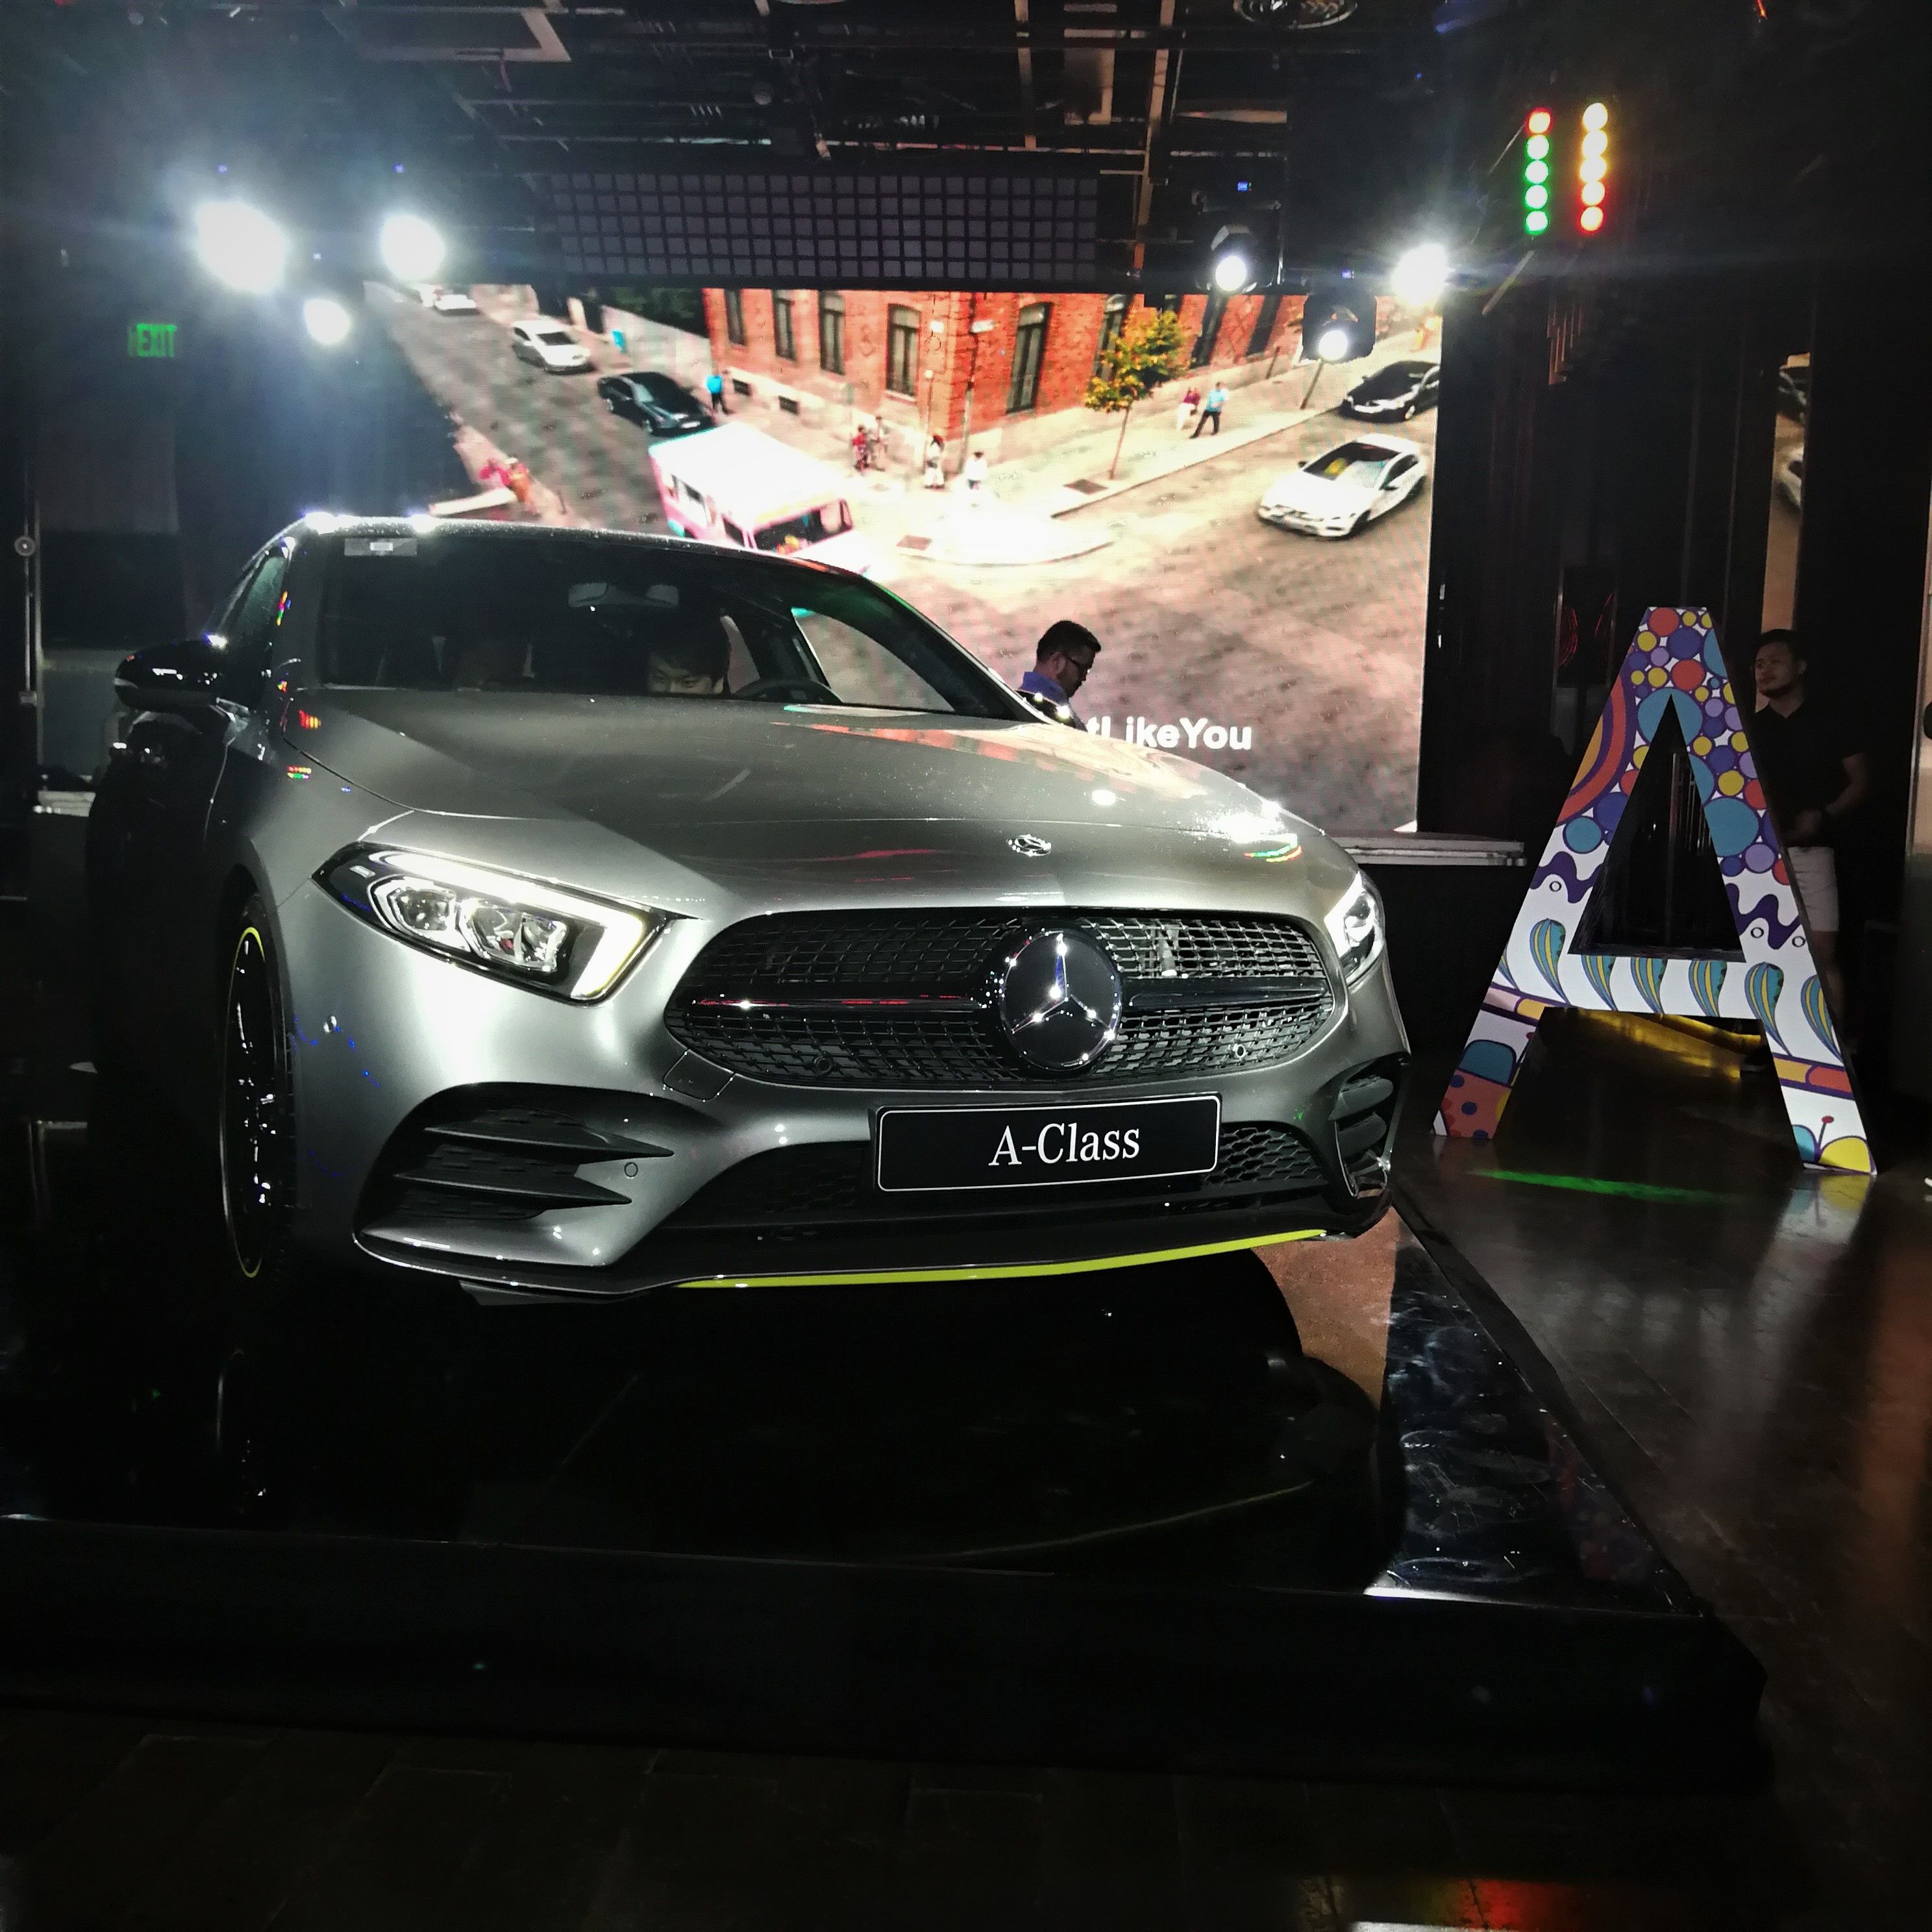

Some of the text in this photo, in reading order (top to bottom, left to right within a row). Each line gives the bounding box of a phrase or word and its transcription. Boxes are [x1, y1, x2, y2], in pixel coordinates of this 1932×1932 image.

[136, 323, 177, 357] EXIT
[1431, 606, 1877, 1175] A
[987, 1122, 1140, 1167] A-Class
